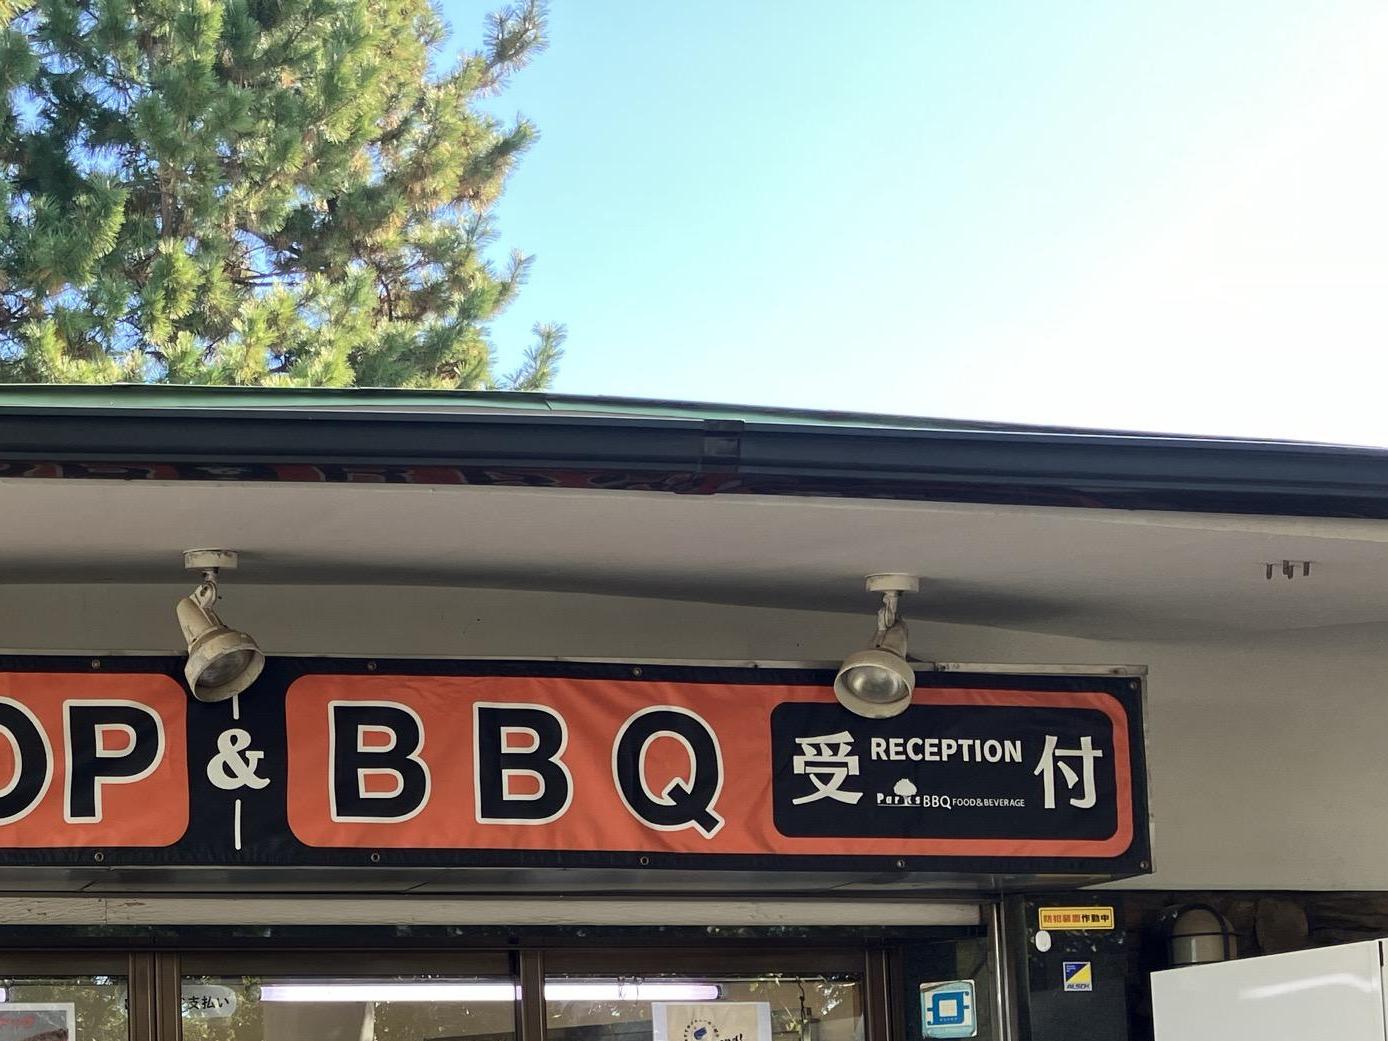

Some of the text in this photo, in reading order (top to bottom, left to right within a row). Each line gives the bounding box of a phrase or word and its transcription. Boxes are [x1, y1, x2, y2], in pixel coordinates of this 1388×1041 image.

[206, 728, 272, 791] &
[792, 730, 864, 806] 受
[870, 737, 1023, 763] RECEPTION
[1033, 734, 1103, 810] 付
[923, 795, 952, 809] BBQ
[181, 996, 230, 1009] 支払い
